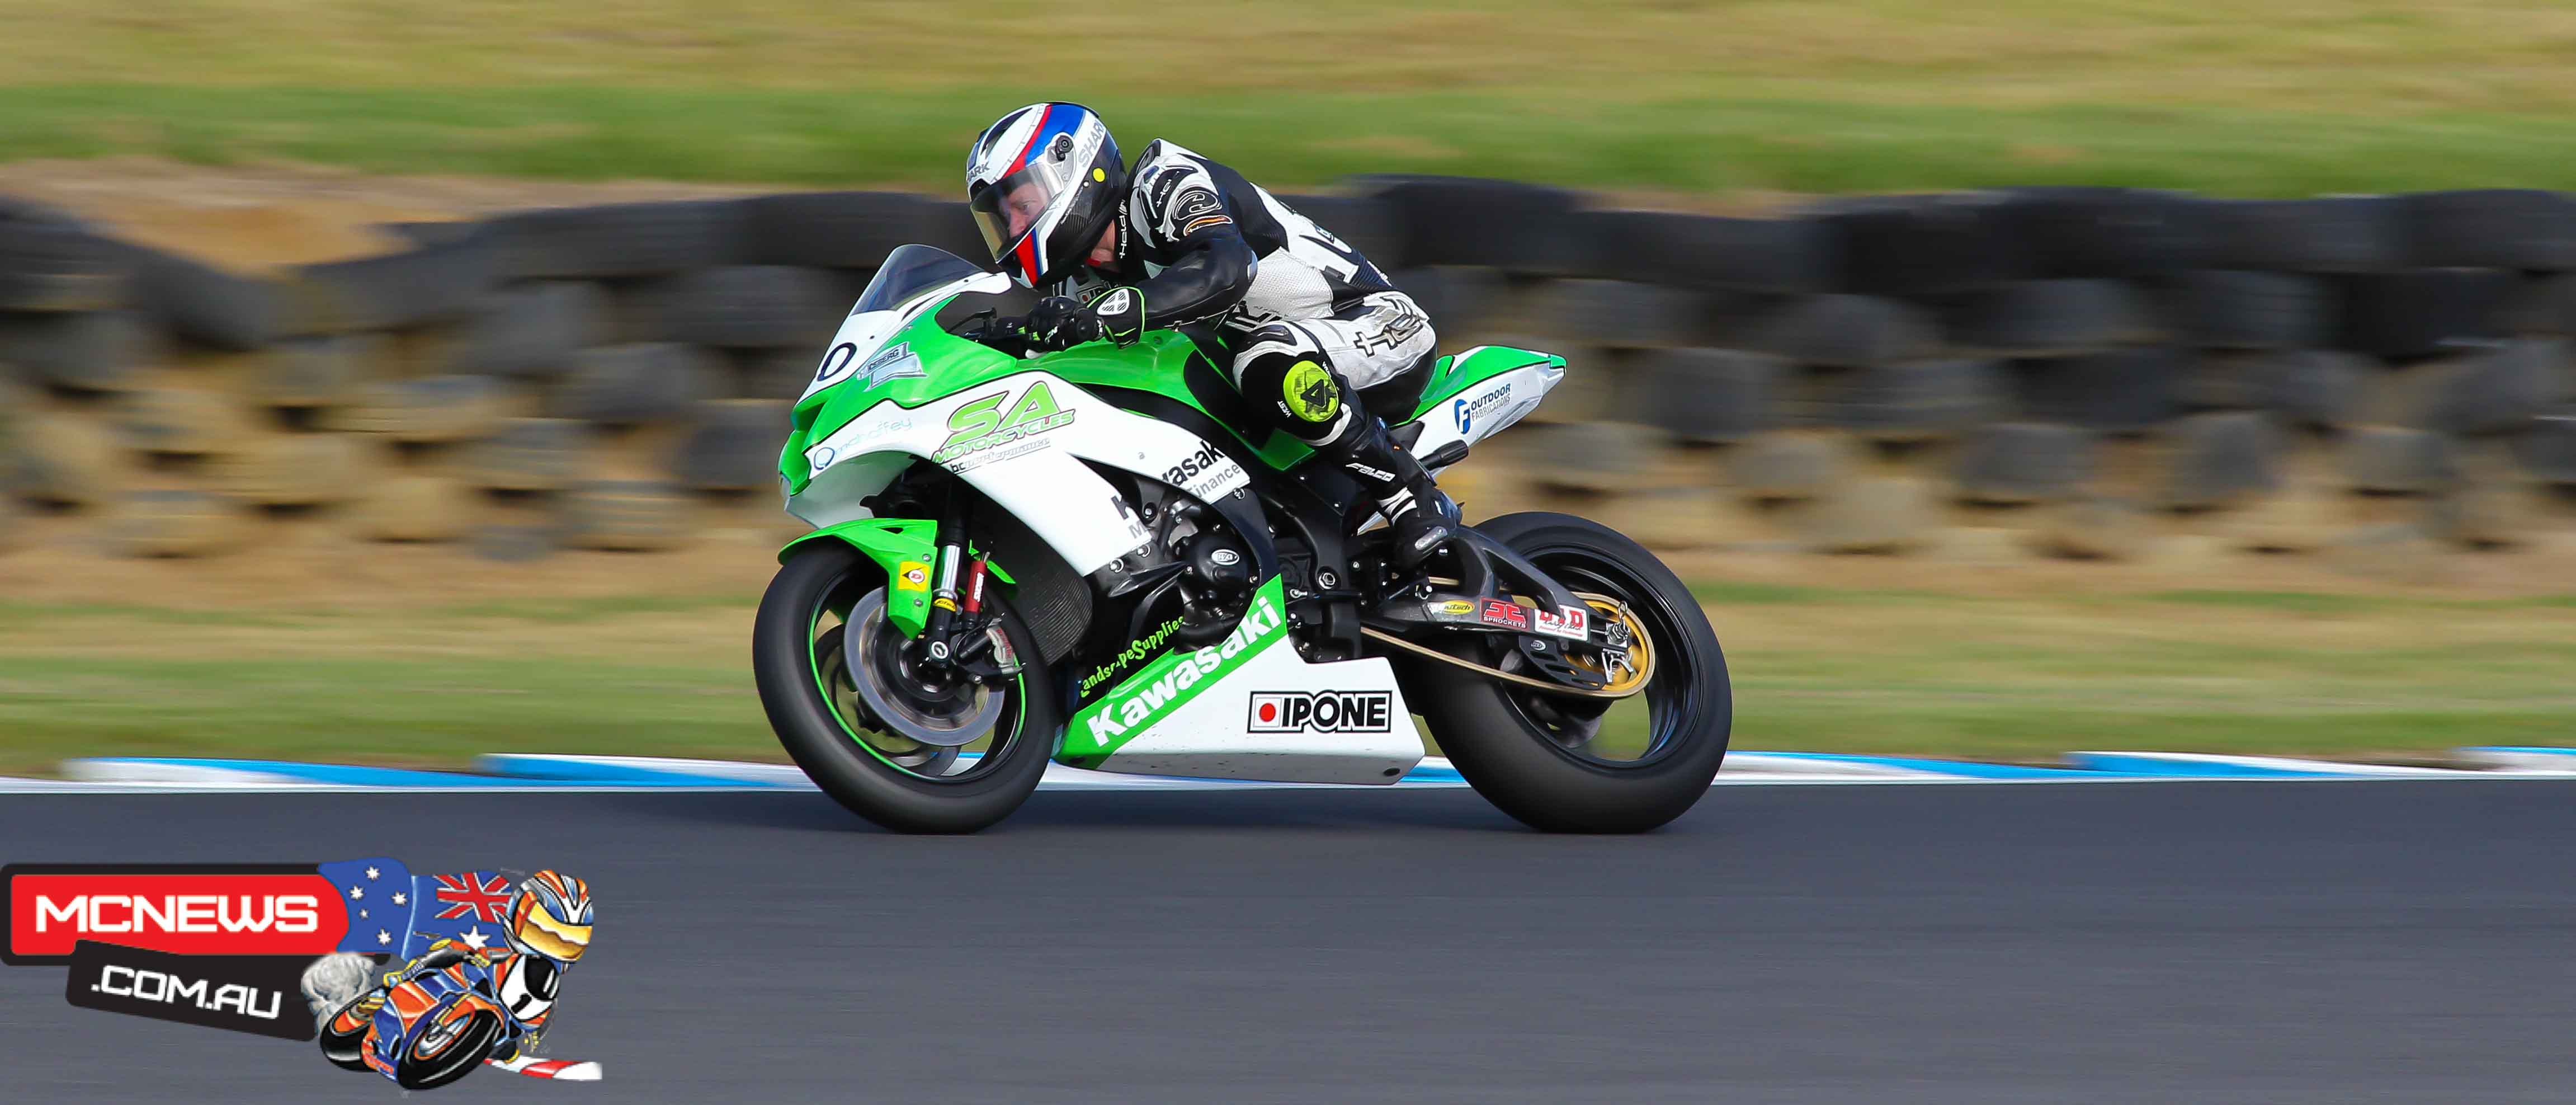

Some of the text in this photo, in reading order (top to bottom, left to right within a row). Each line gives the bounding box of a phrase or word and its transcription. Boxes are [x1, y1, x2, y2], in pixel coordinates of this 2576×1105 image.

[1078, 119, 1106, 168] SHAR
[940, 380, 1061, 450] SA
[1471, 383, 1511, 410] OUTDOOR
[1471, 393, 1511, 422] FABRICATIONS
[931, 409, 1075, 464] MOTORCYCLES
[1087, 596, 1281, 747] Kawasaki
[1283, 697, 1386, 728] IPONE
